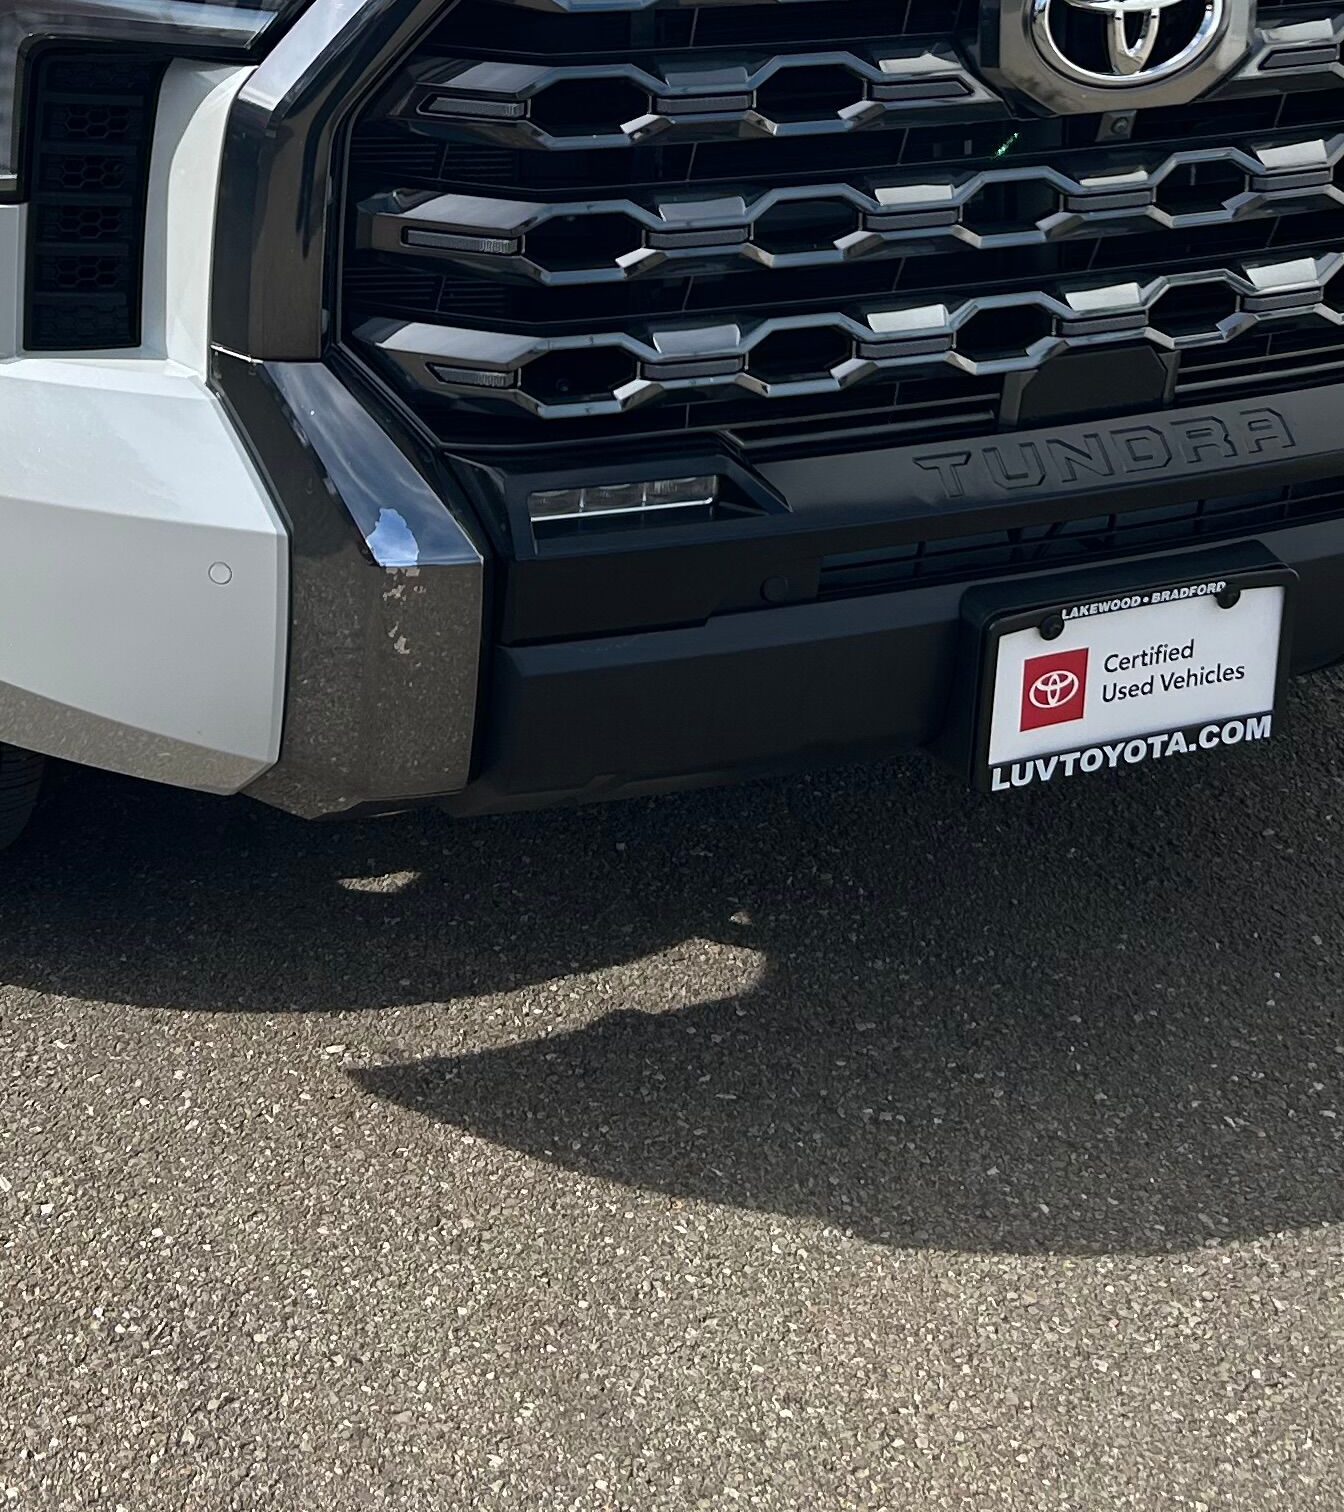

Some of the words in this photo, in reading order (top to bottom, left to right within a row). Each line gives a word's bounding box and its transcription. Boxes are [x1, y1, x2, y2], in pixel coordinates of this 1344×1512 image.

[912, 406, 1297, 499] TUNDRA
[1061, 595, 1141, 620] LAKEWOOD
[1151, 581, 1227, 604] BRADFORD
[1103, 638, 1195, 673] Certified
[1101, 674, 1155, 703] Used
[1159, 663, 1246, 693] Vehicles
[990, 714, 1273, 792] LUVTOYOTA.COM
